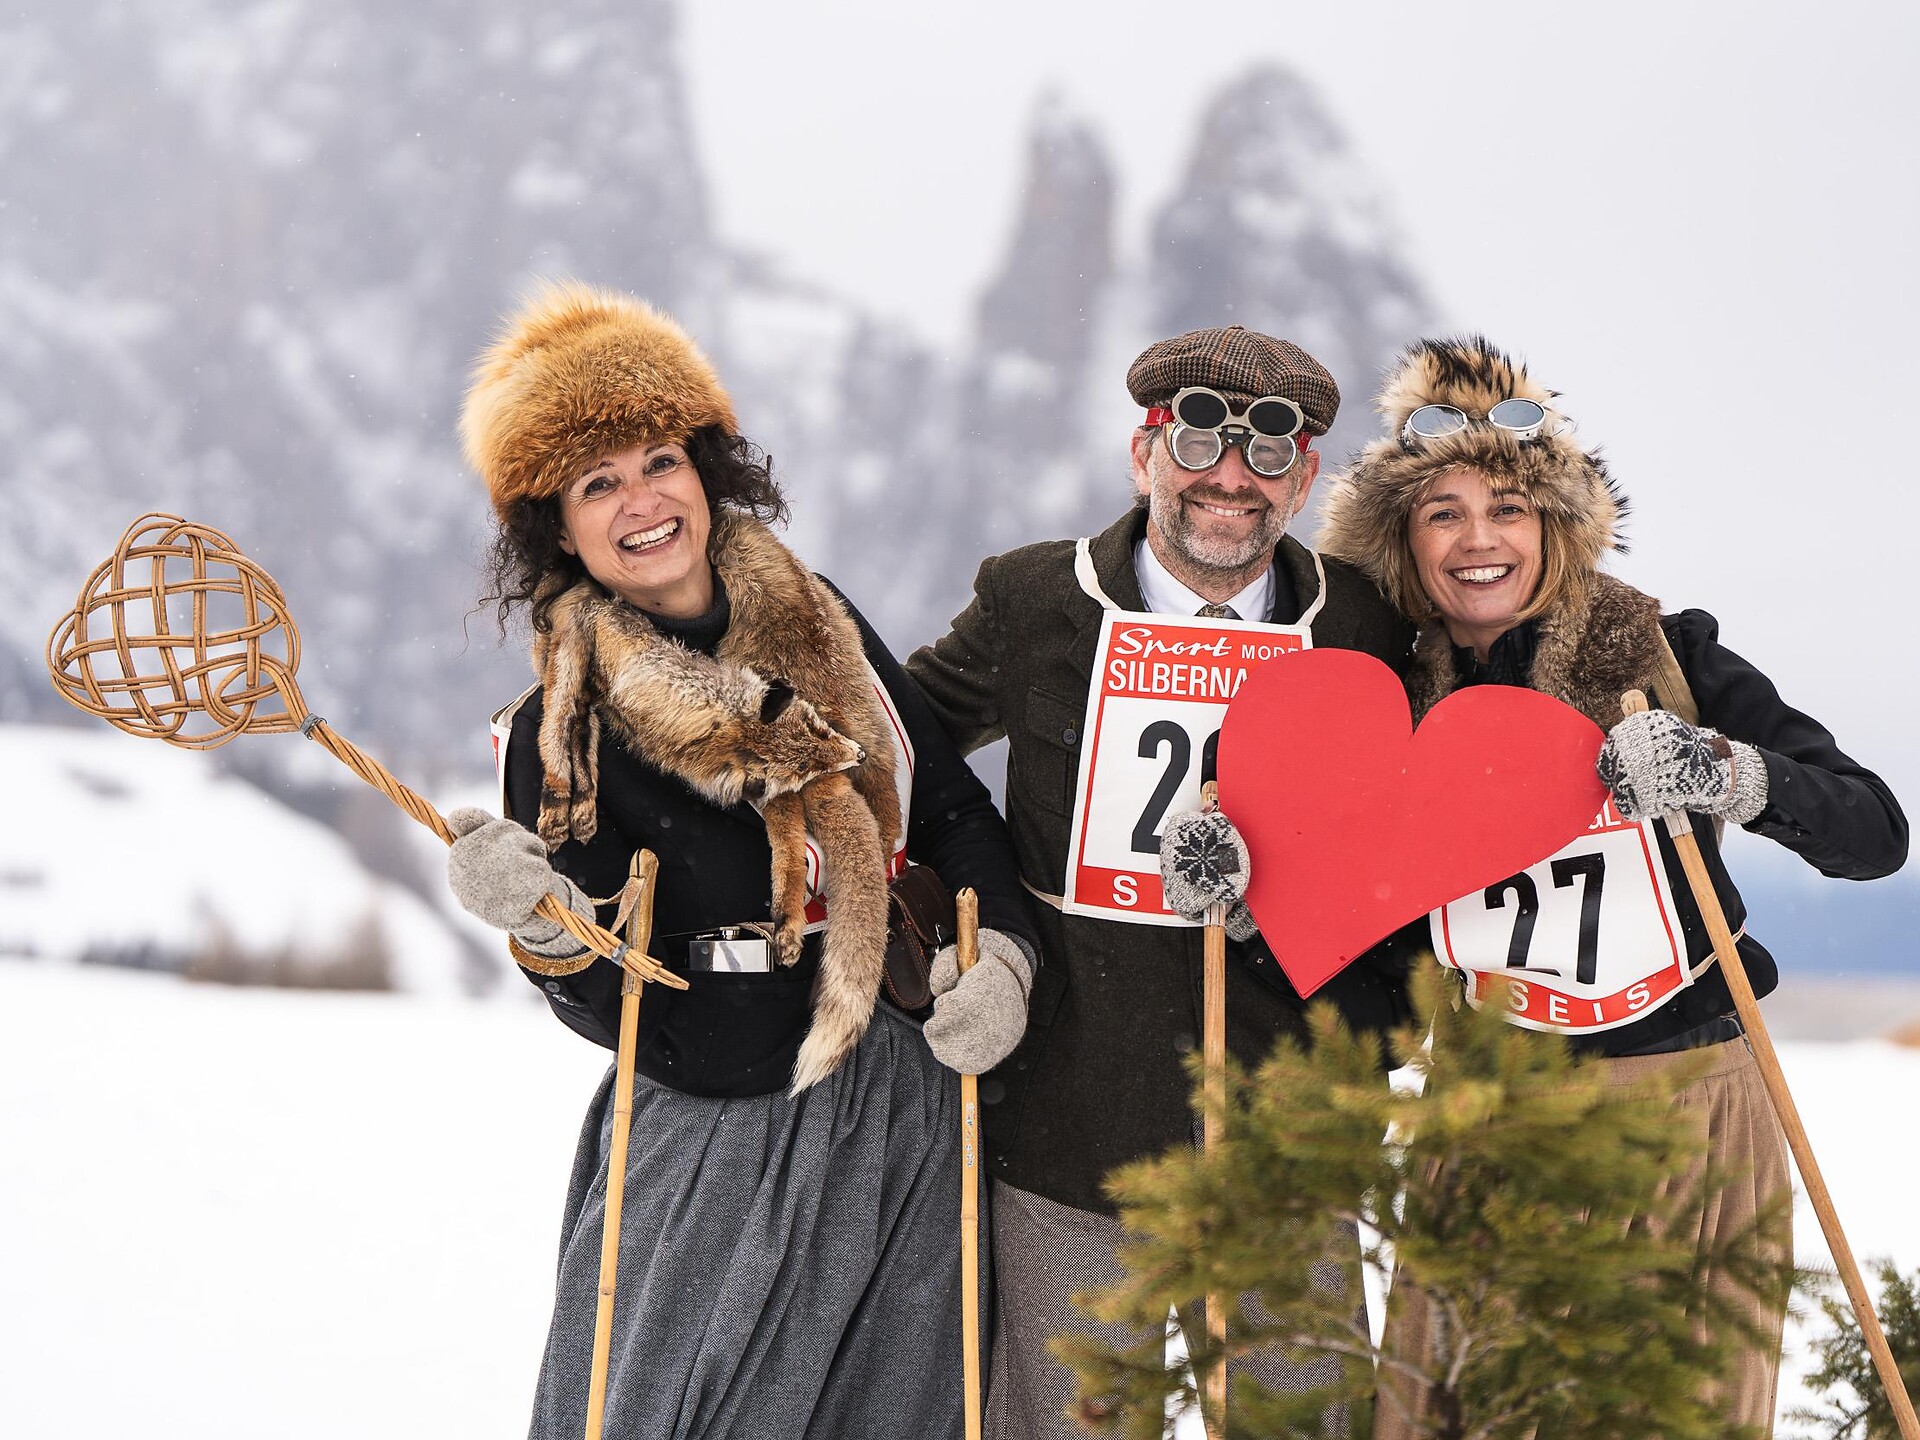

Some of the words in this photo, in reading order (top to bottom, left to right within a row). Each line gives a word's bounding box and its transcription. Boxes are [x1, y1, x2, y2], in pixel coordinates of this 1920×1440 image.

[1113, 627, 1233, 659] Sport
[1484, 851, 1606, 985] 27
[1507, 981, 1651, 1025] SEIS
